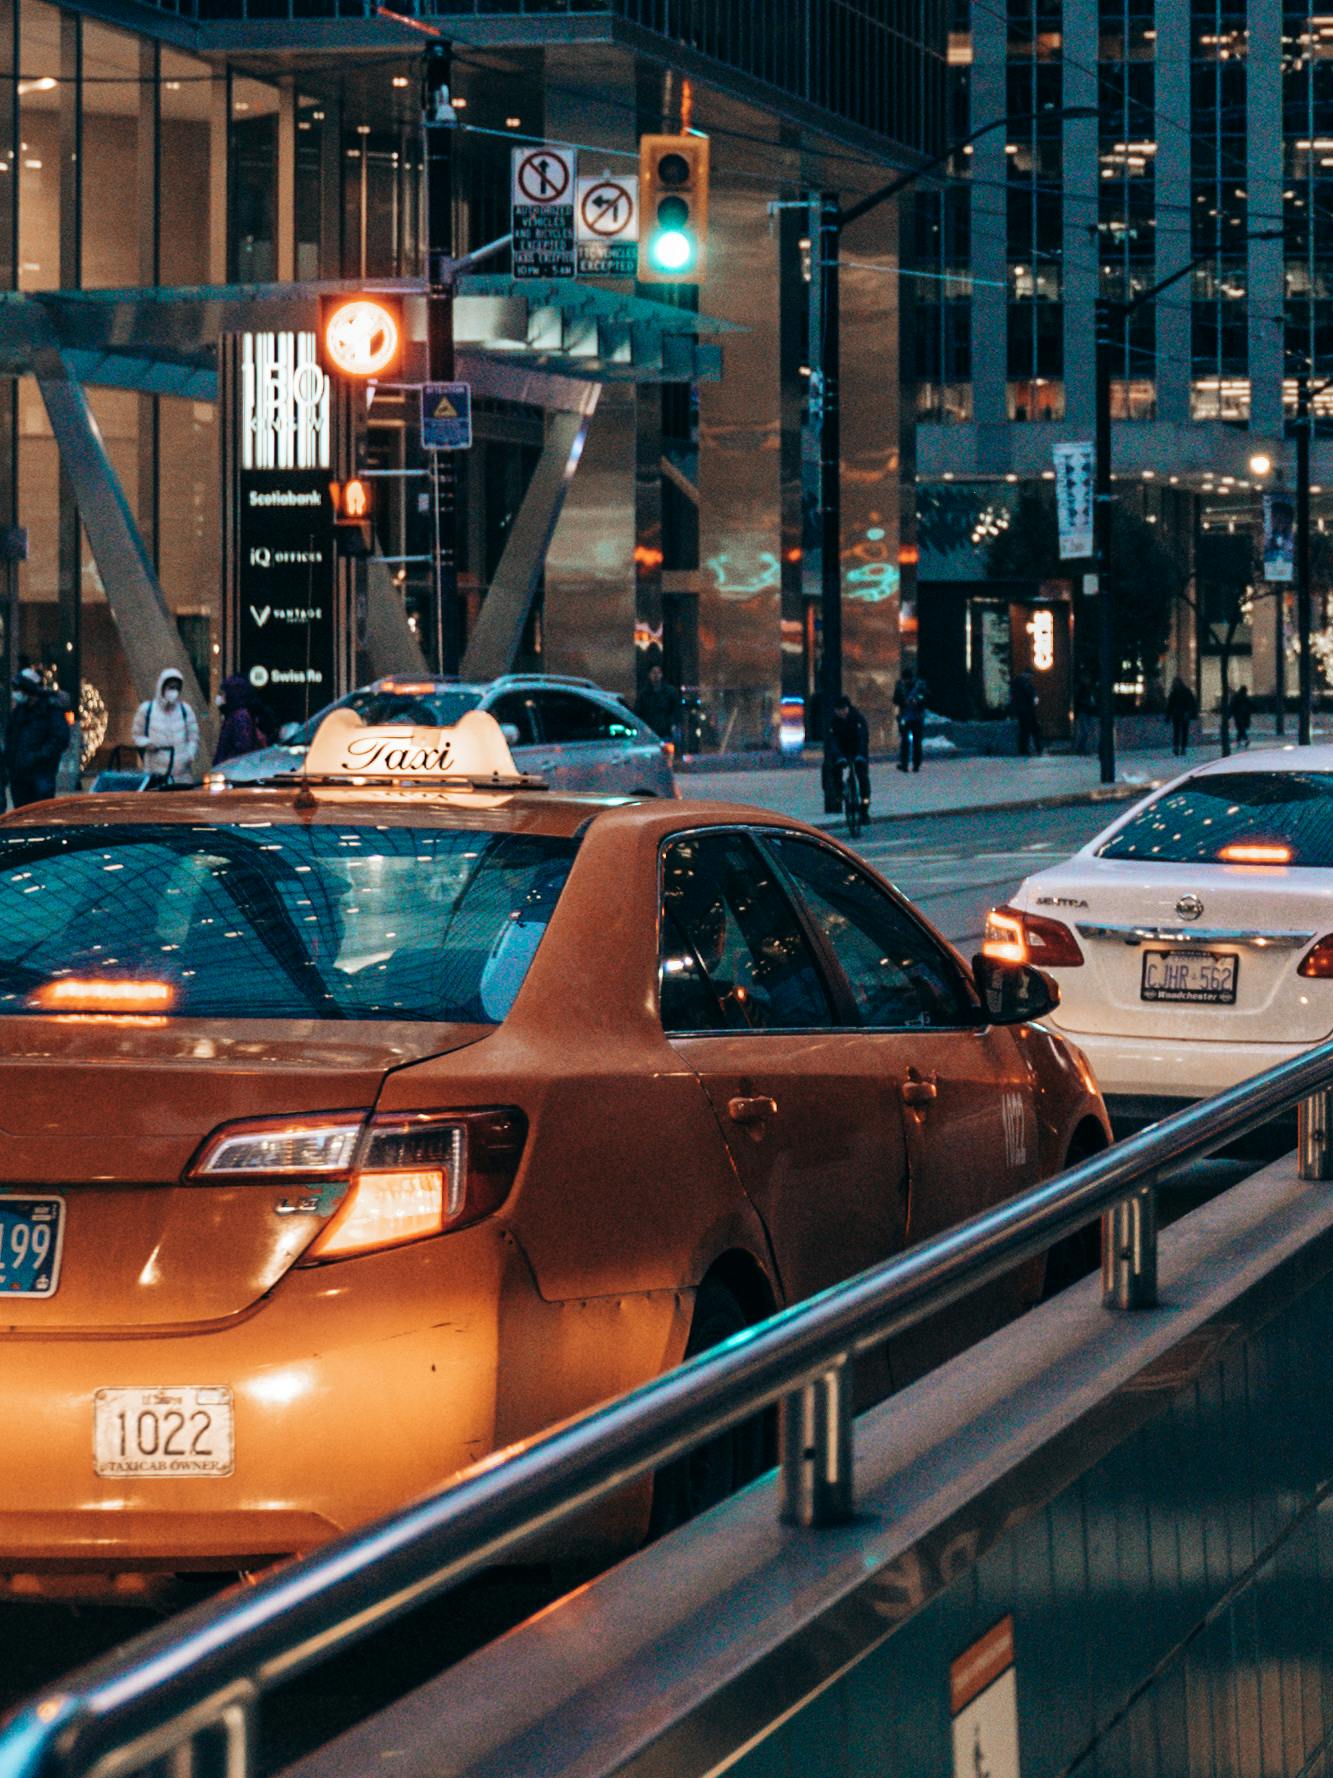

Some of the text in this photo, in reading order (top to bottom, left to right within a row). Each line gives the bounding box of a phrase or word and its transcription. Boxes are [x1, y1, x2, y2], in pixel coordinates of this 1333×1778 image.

[580, 260, 634, 271] EXCEPTED
[250, 489, 321, 506] Scotiabank
[341, 735, 454, 771] Taxi
[0, 1223, 51, 1270] 99
[117, 1409, 213, 1457] 1022
[108, 1458, 219, 1472] TAXICAB OWNER
